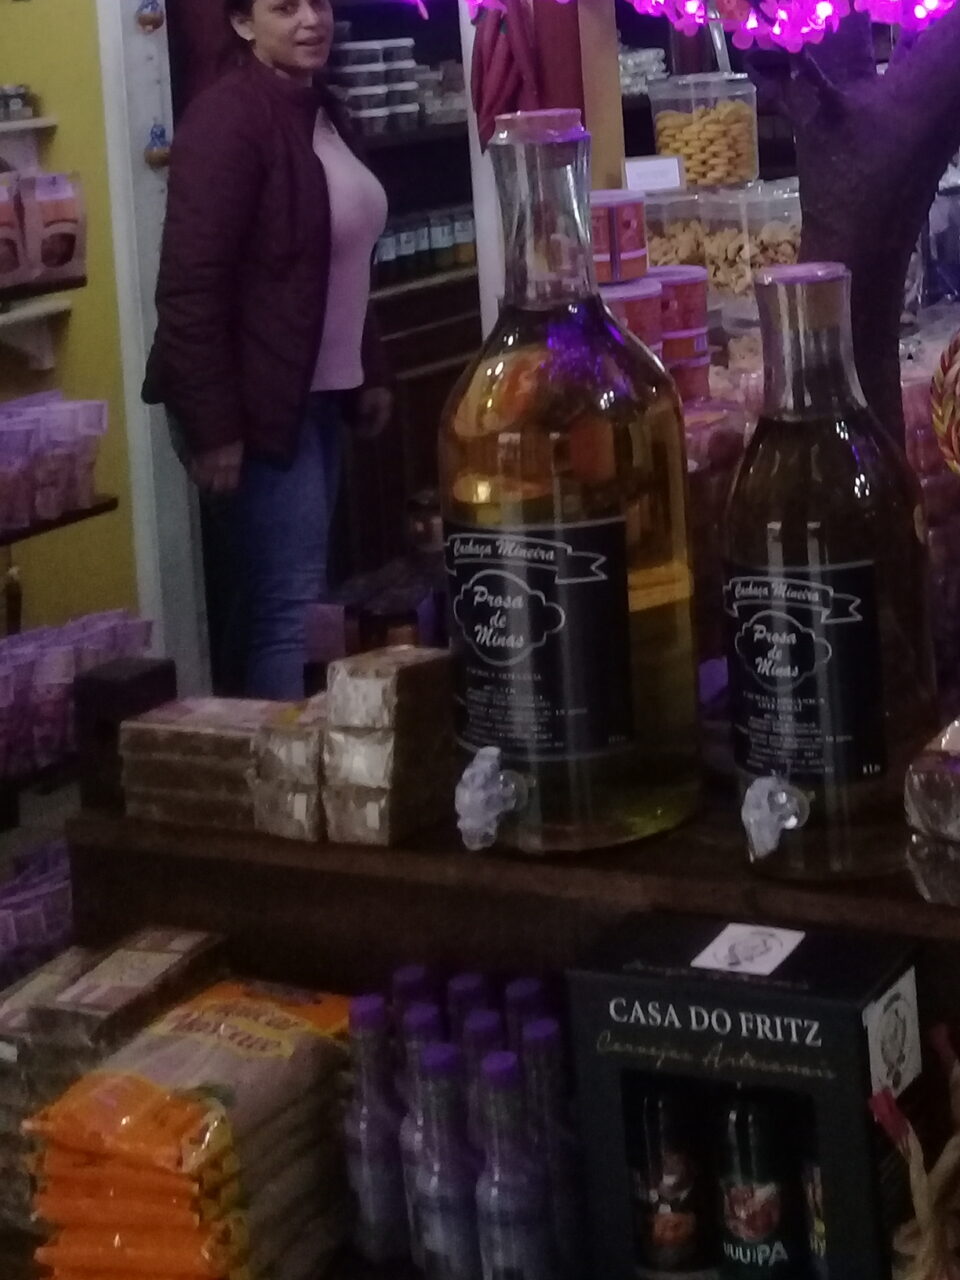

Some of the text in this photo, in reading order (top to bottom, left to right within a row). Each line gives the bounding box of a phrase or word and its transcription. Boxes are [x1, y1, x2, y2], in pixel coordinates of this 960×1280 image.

[473, 585, 526, 608] Prosa
[489, 610, 508, 629] de
[473, 624, 525, 649] Minas
[752, 624, 797, 645] Prosa
[767, 644, 783, 661] de
[754, 657, 799, 678] Minas
[609, 997, 823, 1048] CASA DO FRITZ
